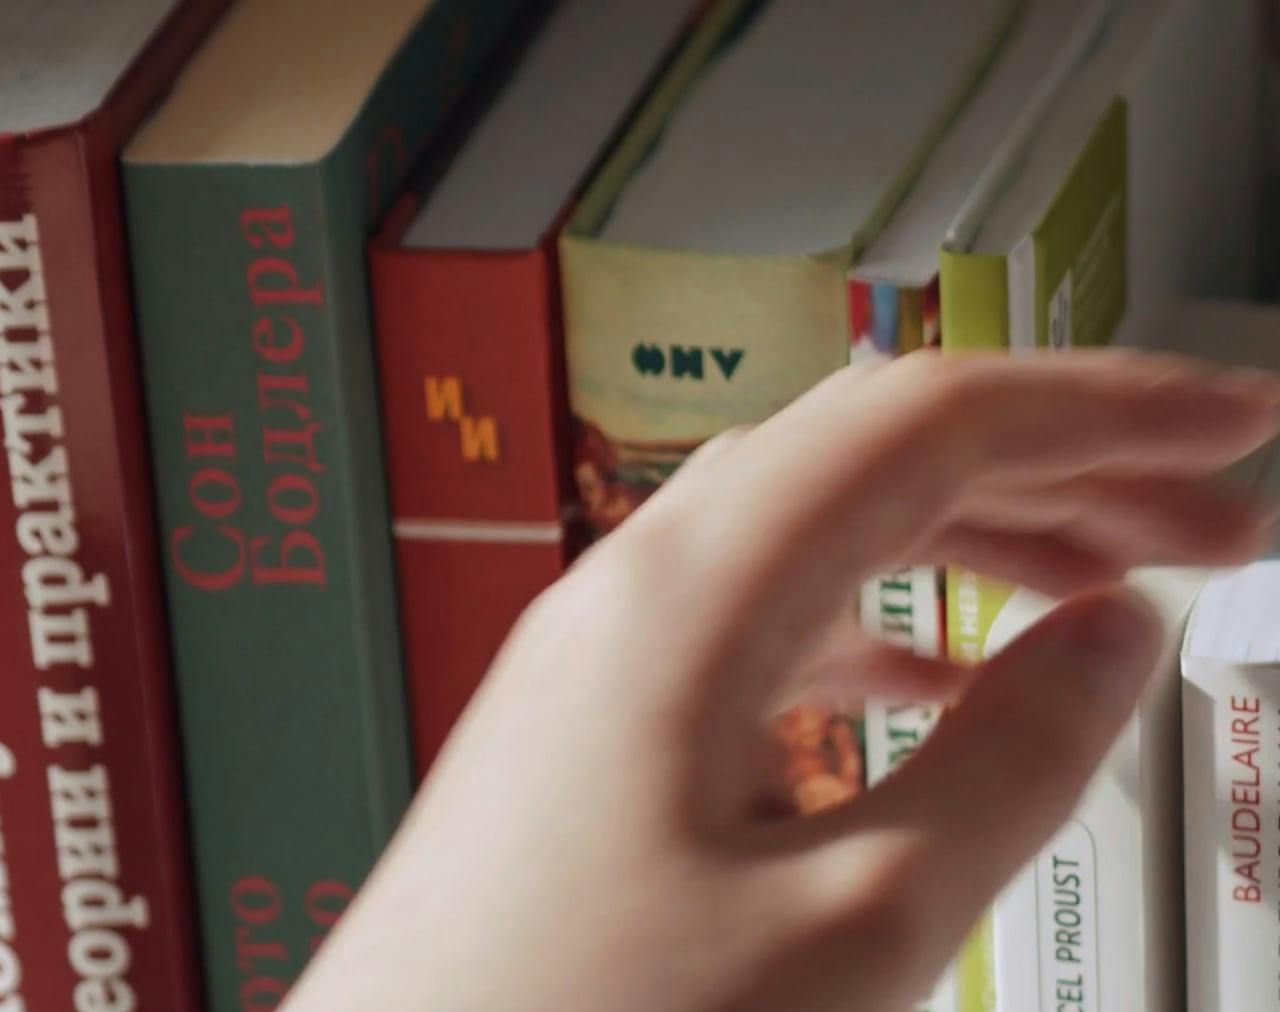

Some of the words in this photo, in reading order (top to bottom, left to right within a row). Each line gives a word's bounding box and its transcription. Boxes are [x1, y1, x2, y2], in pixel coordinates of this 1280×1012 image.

[240, 204, 328, 588] Бодлера
[171, 409, 248, 592] Сон
[37, 685, 103, 749] и
[1231, 696, 1263, 903] BAUDELAIRE
[1052, 855, 1082, 963] PROUST
